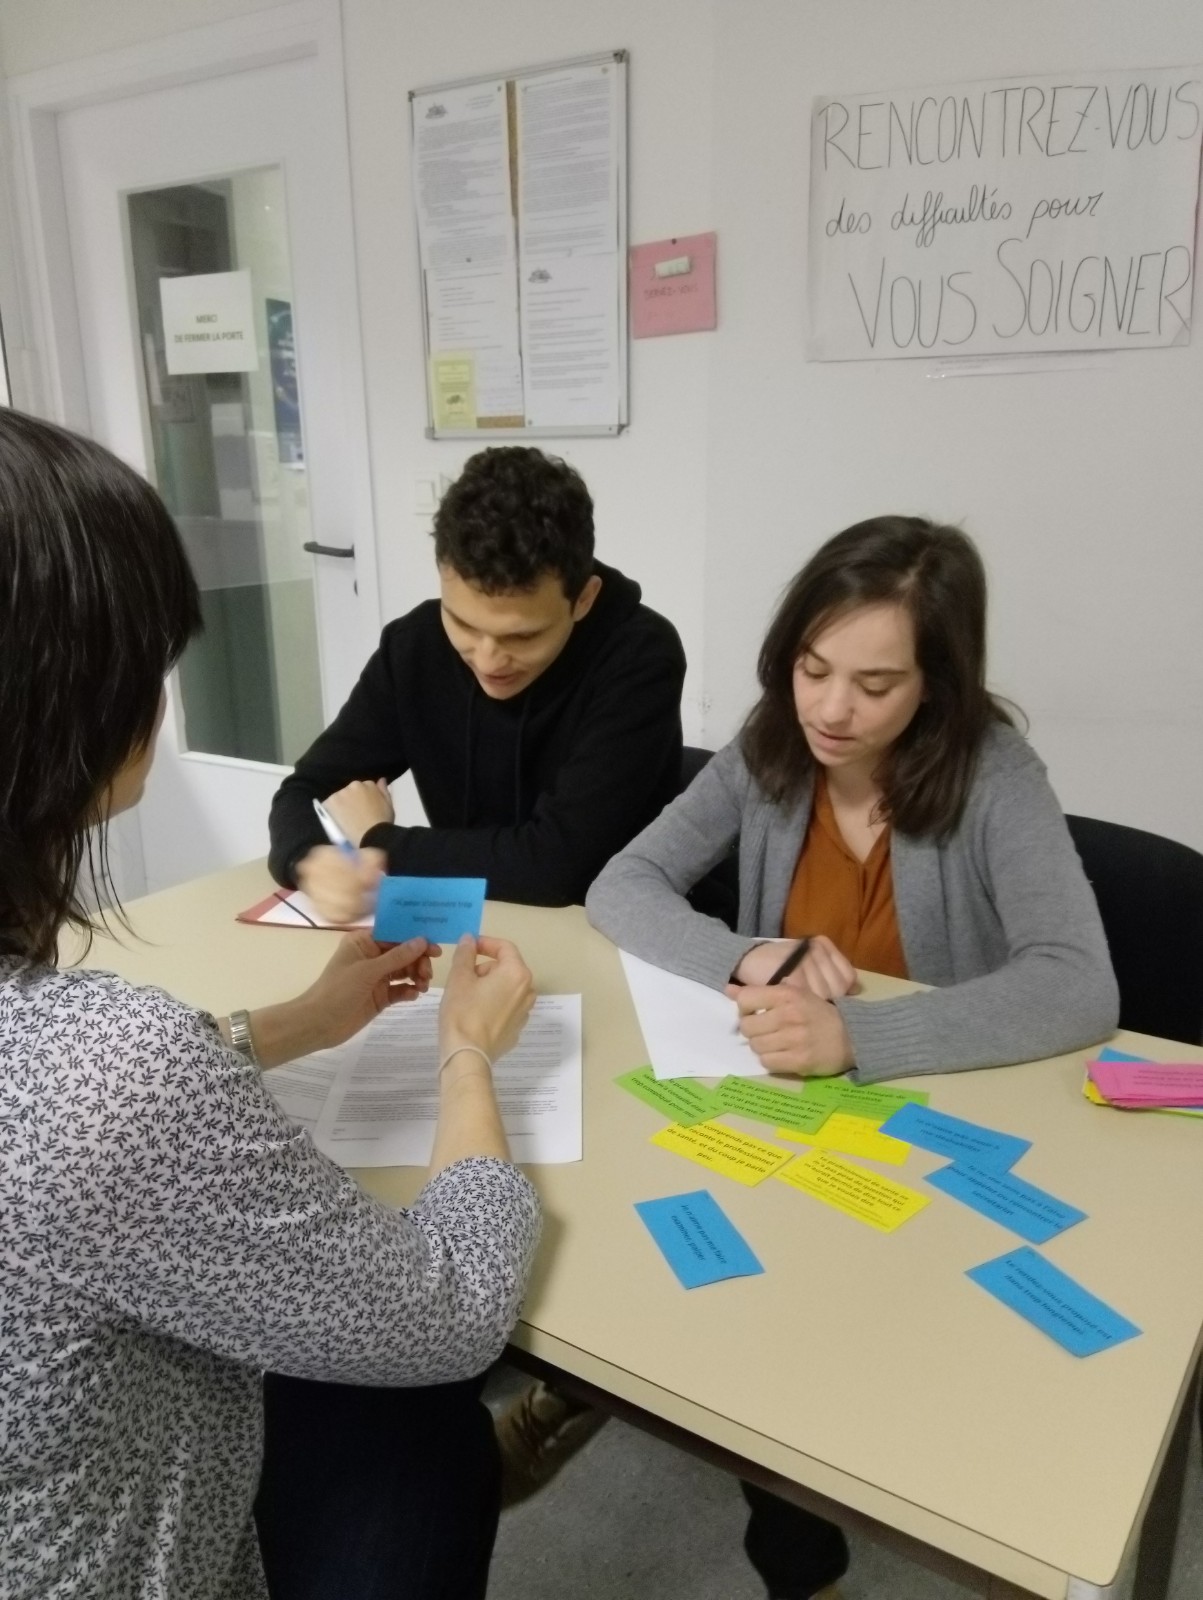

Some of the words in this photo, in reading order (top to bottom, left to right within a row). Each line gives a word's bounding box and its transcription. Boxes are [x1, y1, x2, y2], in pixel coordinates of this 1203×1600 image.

[825, 197, 871, 237] des
[891, 184, 1013, 248] difficultés
[1027, 191, 1104, 239] pour
[848, 257, 977, 348] VOUS
[992, 238, 1191, 338] SOIGNER
[196, 314, 218, 323] MERCI
[174, 334, 182, 343] DE
[184, 333, 210, 342] FERMER
[212, 333, 220, 341] LA
[222, 331, 243, 340] PORTE
[774, 1107, 814, 1120] demander
[689, 1127, 716, 1141] raconte
[723, 1143, 775, 1166] professionnel
[703, 1124, 742, 1143] comprends
[742, 1141, 757, 1149] pas
[767, 1150, 782, 1159] que
[718, 1151, 737, 1161] coup
[745, 1162, 766, 1173] parle
[827, 1160, 872, 1182] professionnel
[837, 1186, 860, 1200] voulais
[860, 1198, 874, 1206] dire
[862, 1184, 892, 1200] question
[862, 1192, 877, 1200] dire
[877, 1198, 893, 1208] tout
[1004, 1274, 1023, 1290] dans
[1023, 1290, 1042, 1303] trop
[1041, 1303, 1084, 1335] longtemps
[1015, 1268, 1063, 1304] rendez-vous
[1061, 1304, 1098, 1329] proposé
[1096, 1329, 1112, 1339] est
